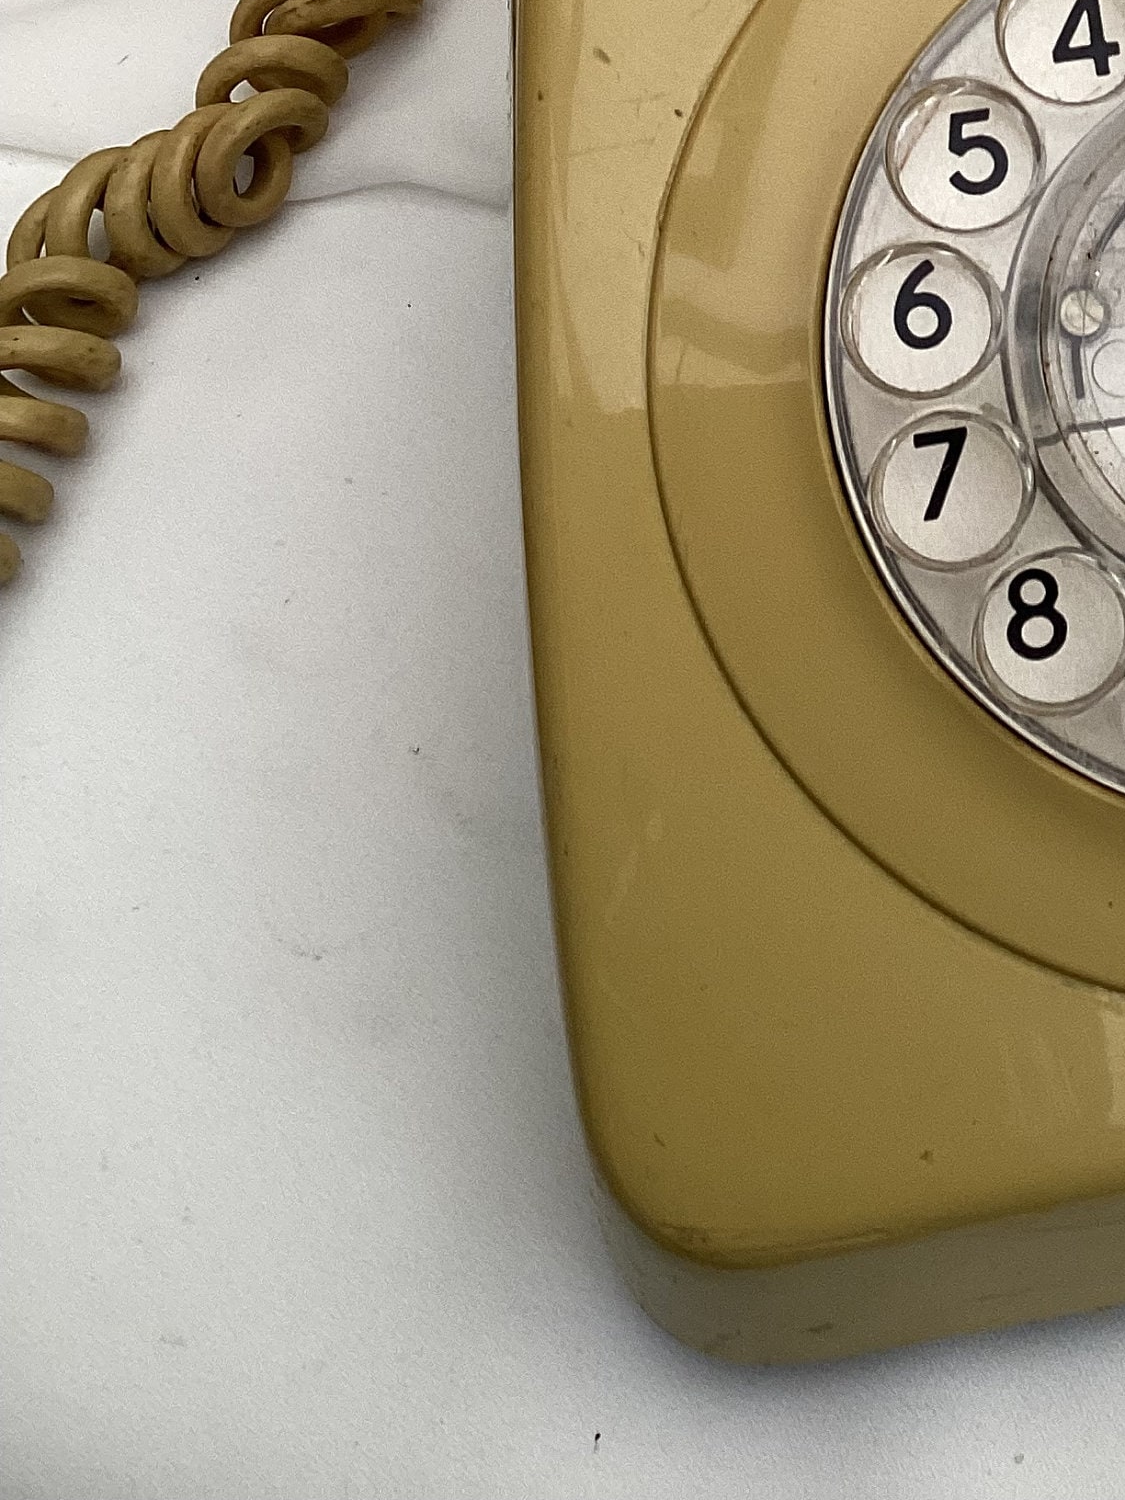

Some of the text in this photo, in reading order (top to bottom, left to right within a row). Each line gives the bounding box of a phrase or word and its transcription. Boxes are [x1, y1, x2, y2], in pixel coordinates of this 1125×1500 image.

[948, 107, 1009, 196] 5
[893, 259, 953, 350] 6
[913, 425, 968, 522] 7
[1006, 568, 1068, 661] 8
